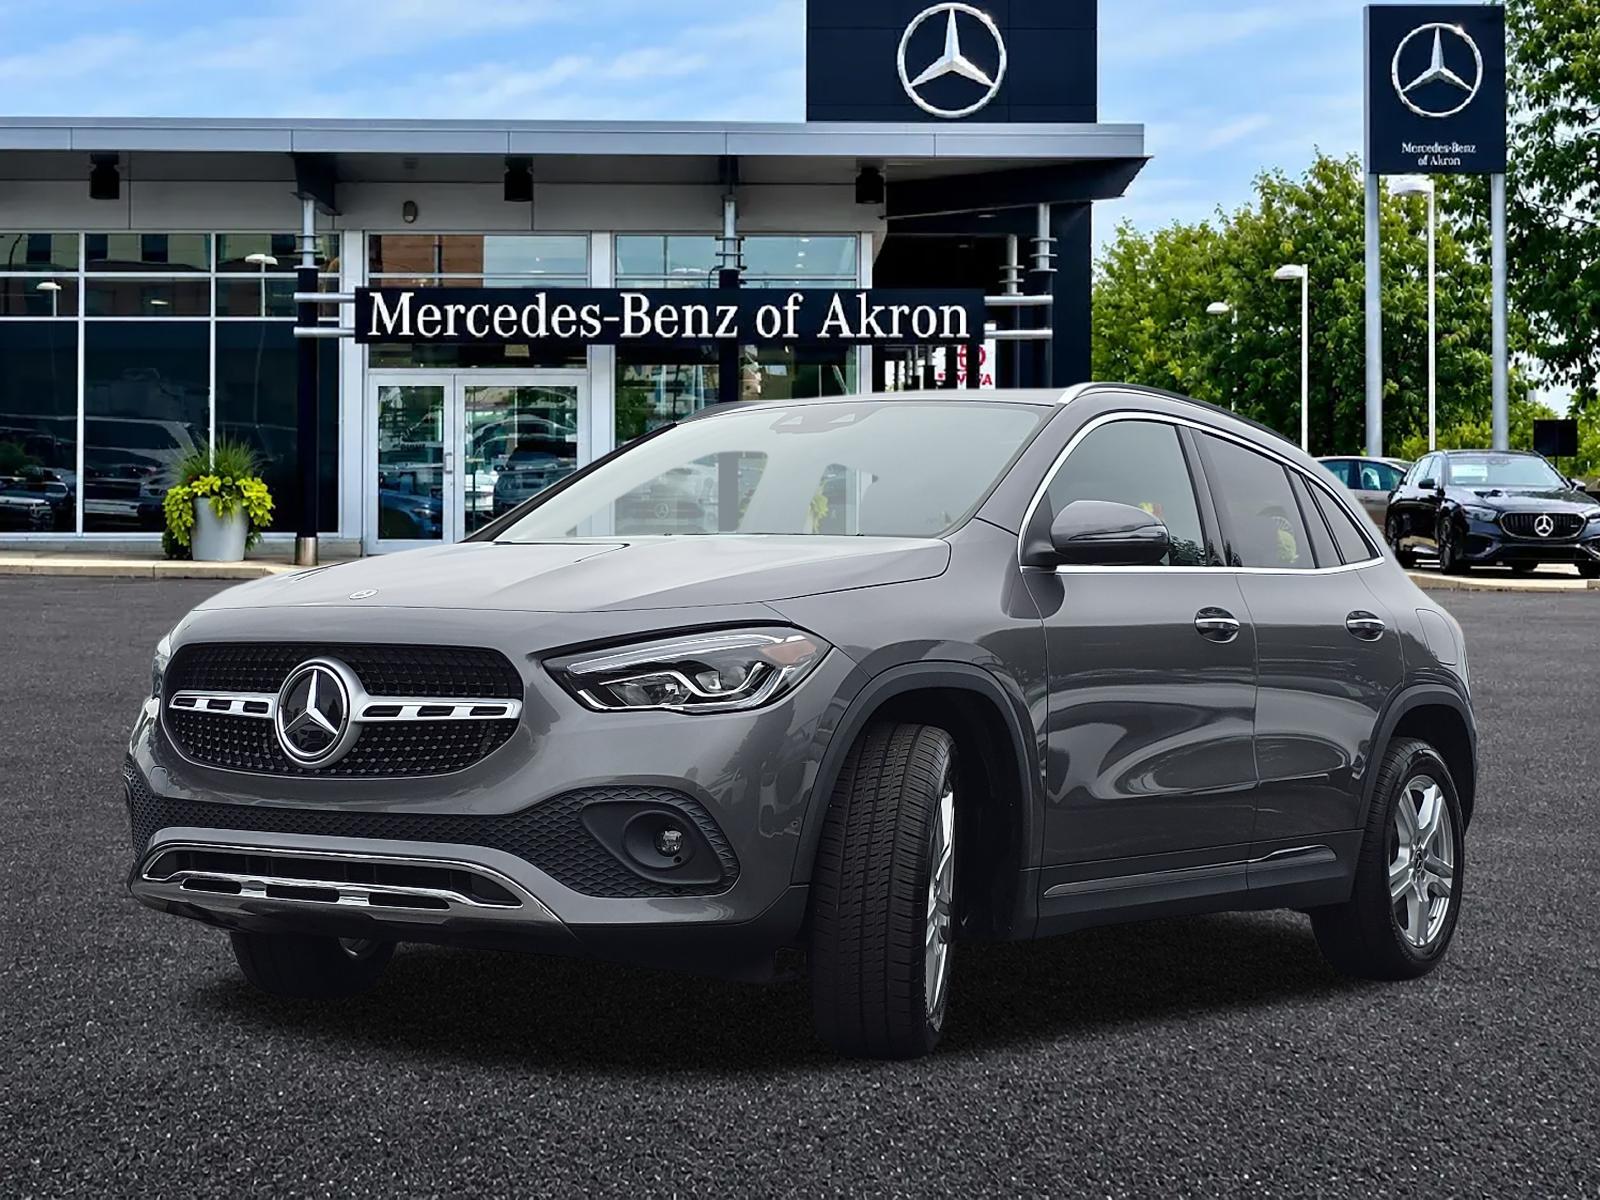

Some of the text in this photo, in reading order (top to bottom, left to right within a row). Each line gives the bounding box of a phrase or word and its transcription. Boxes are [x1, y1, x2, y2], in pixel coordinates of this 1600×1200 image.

[1418, 154, 1461, 166] of Akron
[367, 292, 970, 338] Mercedes-Benz of Akron
